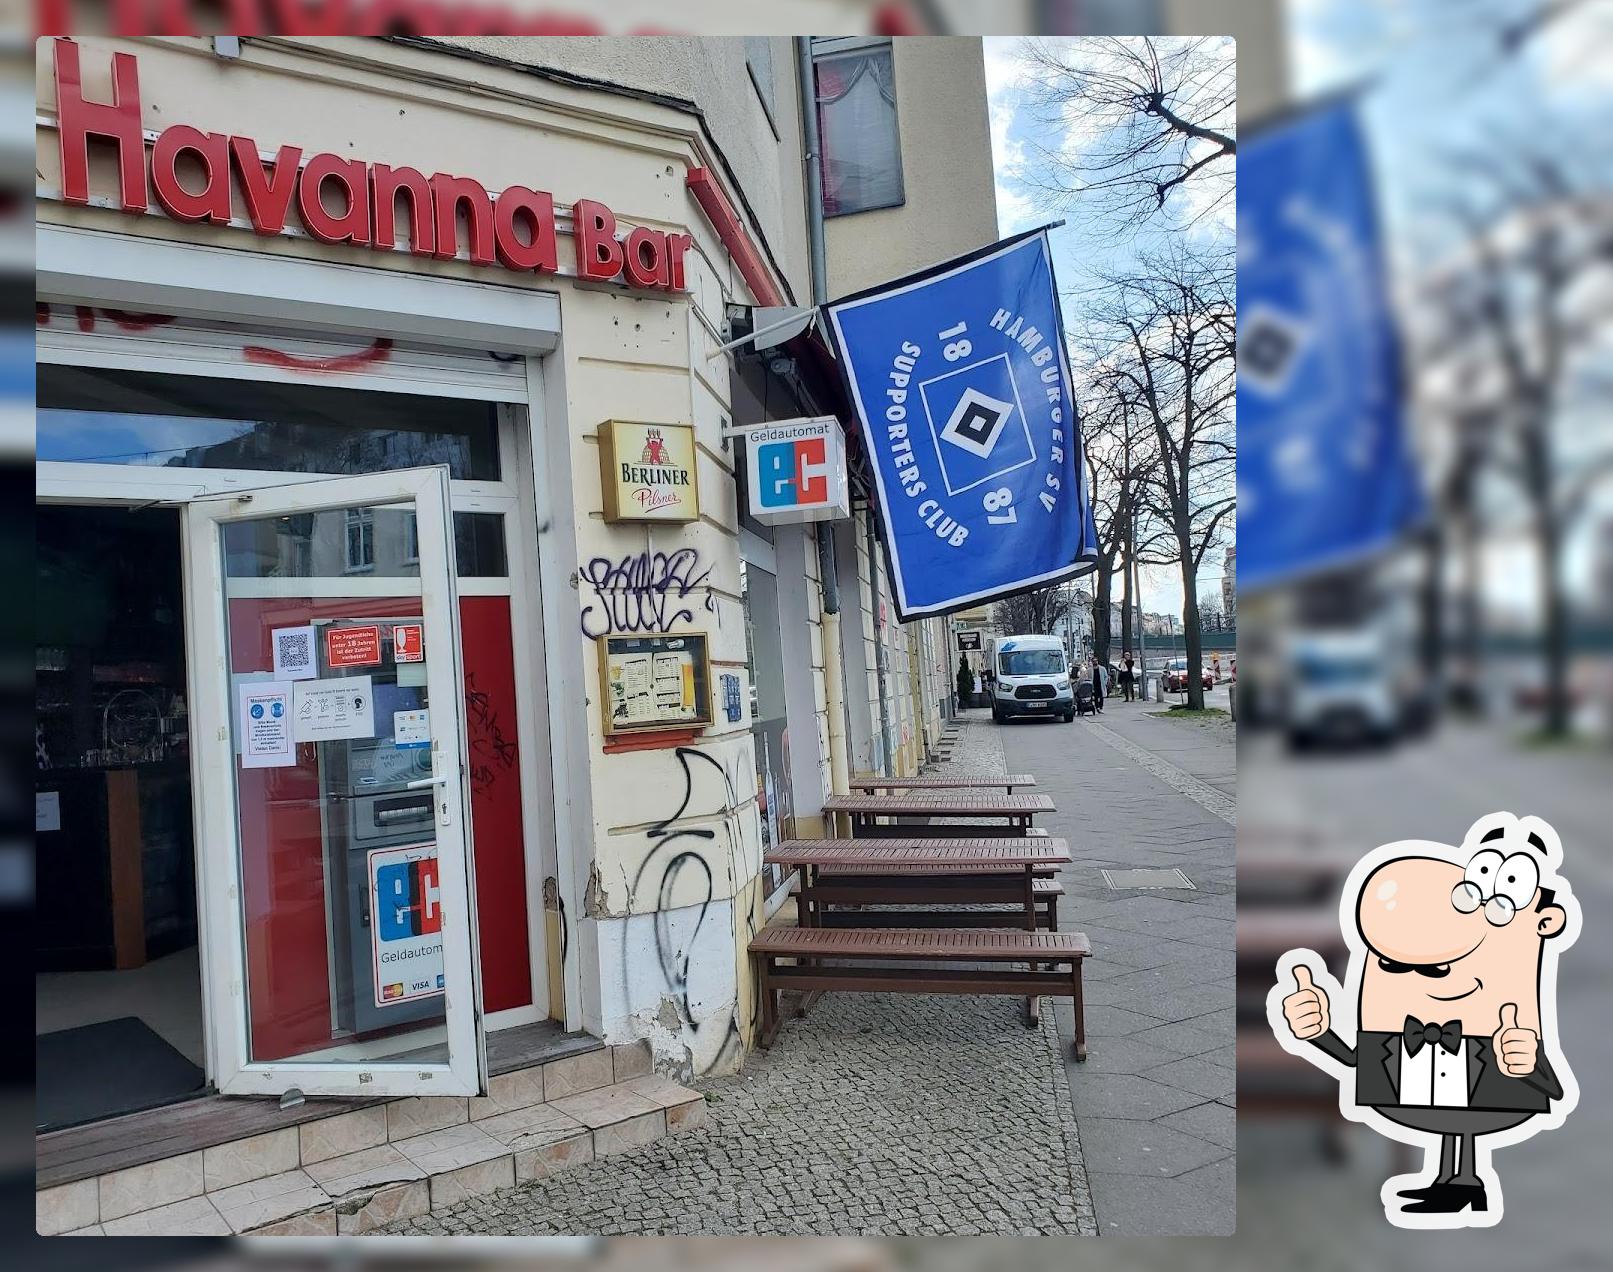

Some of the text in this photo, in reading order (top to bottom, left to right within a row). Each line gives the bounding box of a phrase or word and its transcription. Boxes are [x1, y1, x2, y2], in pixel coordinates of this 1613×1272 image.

[54, 38, 692, 293] Havanna Bar
[938, 320, 973, 362] 18
[989, 307, 1064, 513] HAMBURGER SV
[750, 423, 830, 443] Geldautomat
[885, 340, 970, 547] SUPPORTERS CLUB
[621, 462, 690, 486] BERLINER
[632, 487, 682, 513] Pilsner
[982, 487, 1017, 525] 87
[381, 944, 443, 964] Geldautom
[412, 980, 430, 991] VISA
